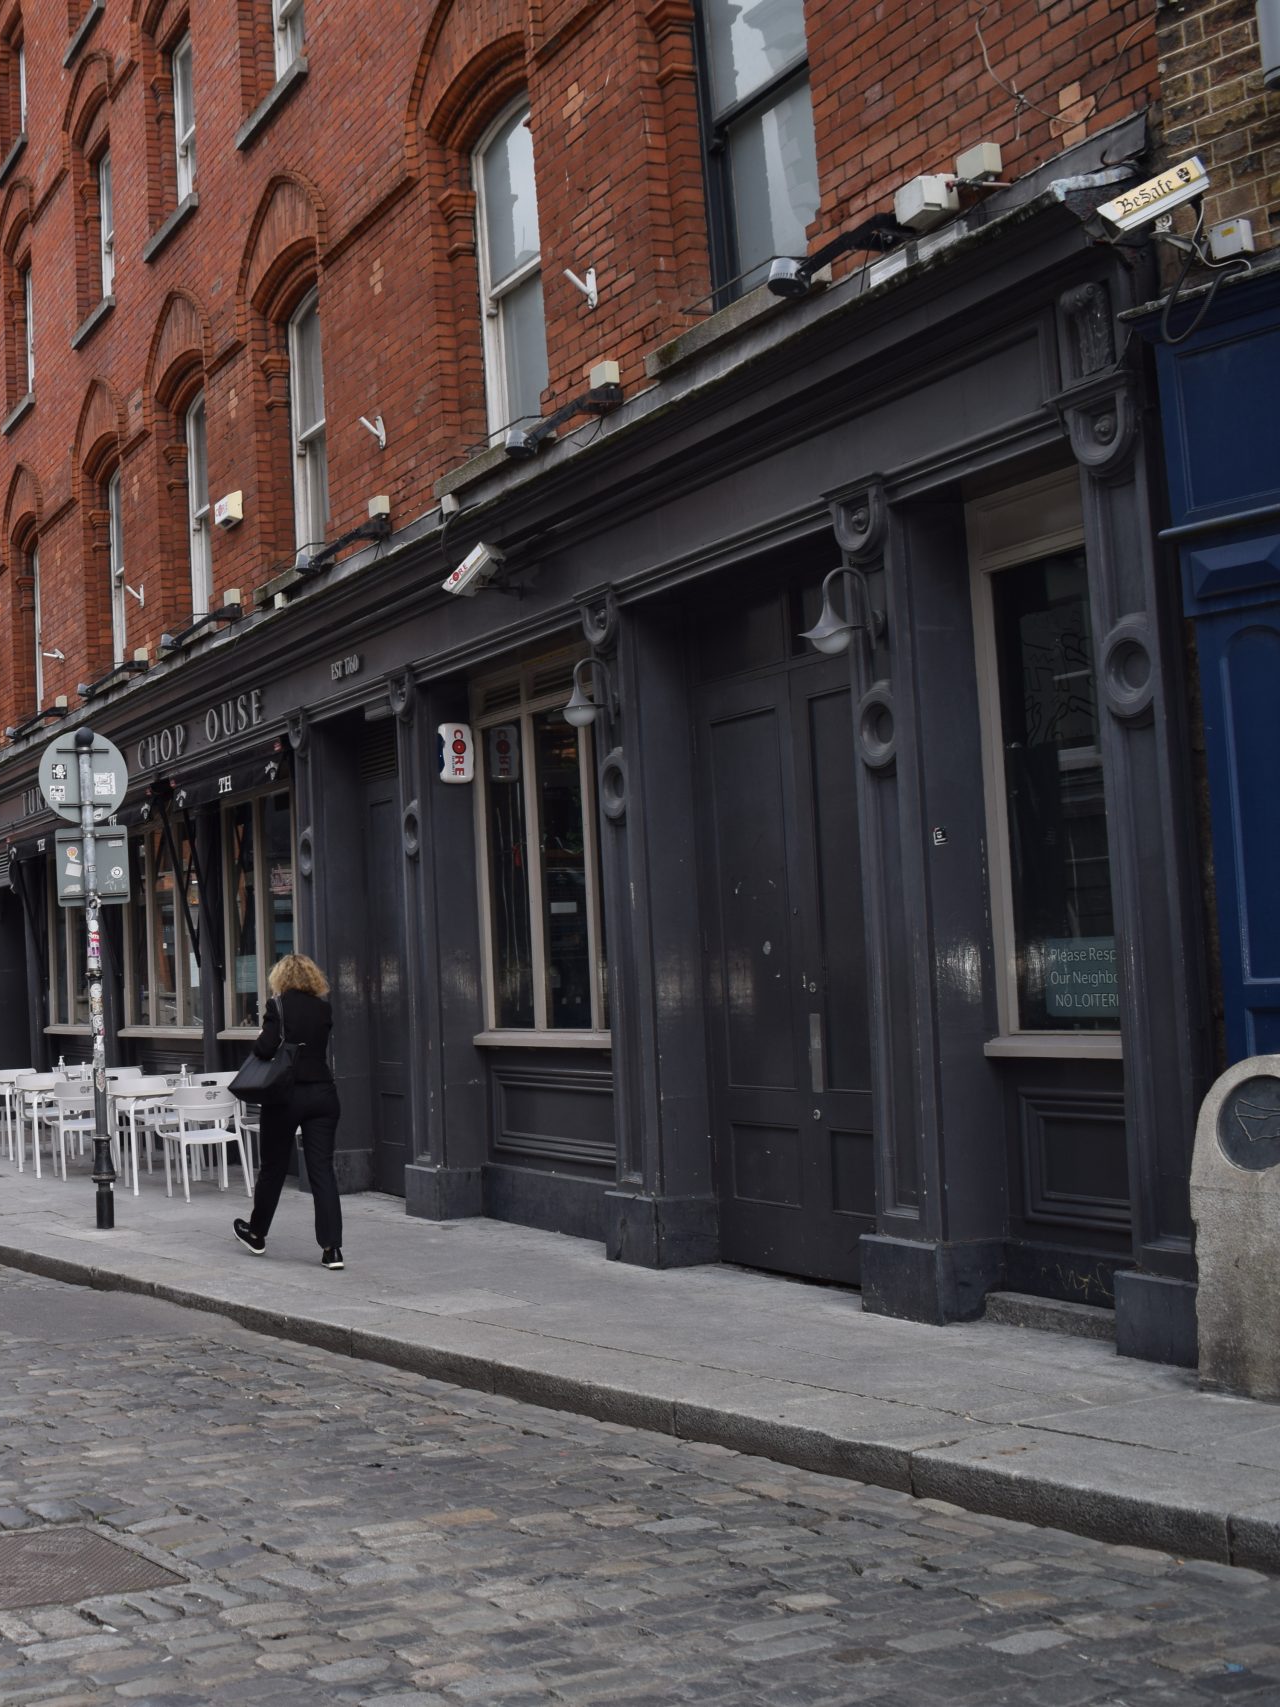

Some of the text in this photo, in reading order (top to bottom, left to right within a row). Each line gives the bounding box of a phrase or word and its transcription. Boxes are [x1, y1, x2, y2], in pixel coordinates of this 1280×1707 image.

[1116, 179, 1174, 215] BeSafe
[448, 562, 468, 585] CORE
[331, 660, 343, 680] EST
[137, 689, 262, 770] CHOP OUSE
[452, 729, 466, 776] CORE
[218, 775, 232, 793] TH
[1049, 947, 1117, 963] Please Resp
[1051, 970, 1119, 987] Our Neighbo
[1056, 993, 1119, 1007] NO LOITERI
